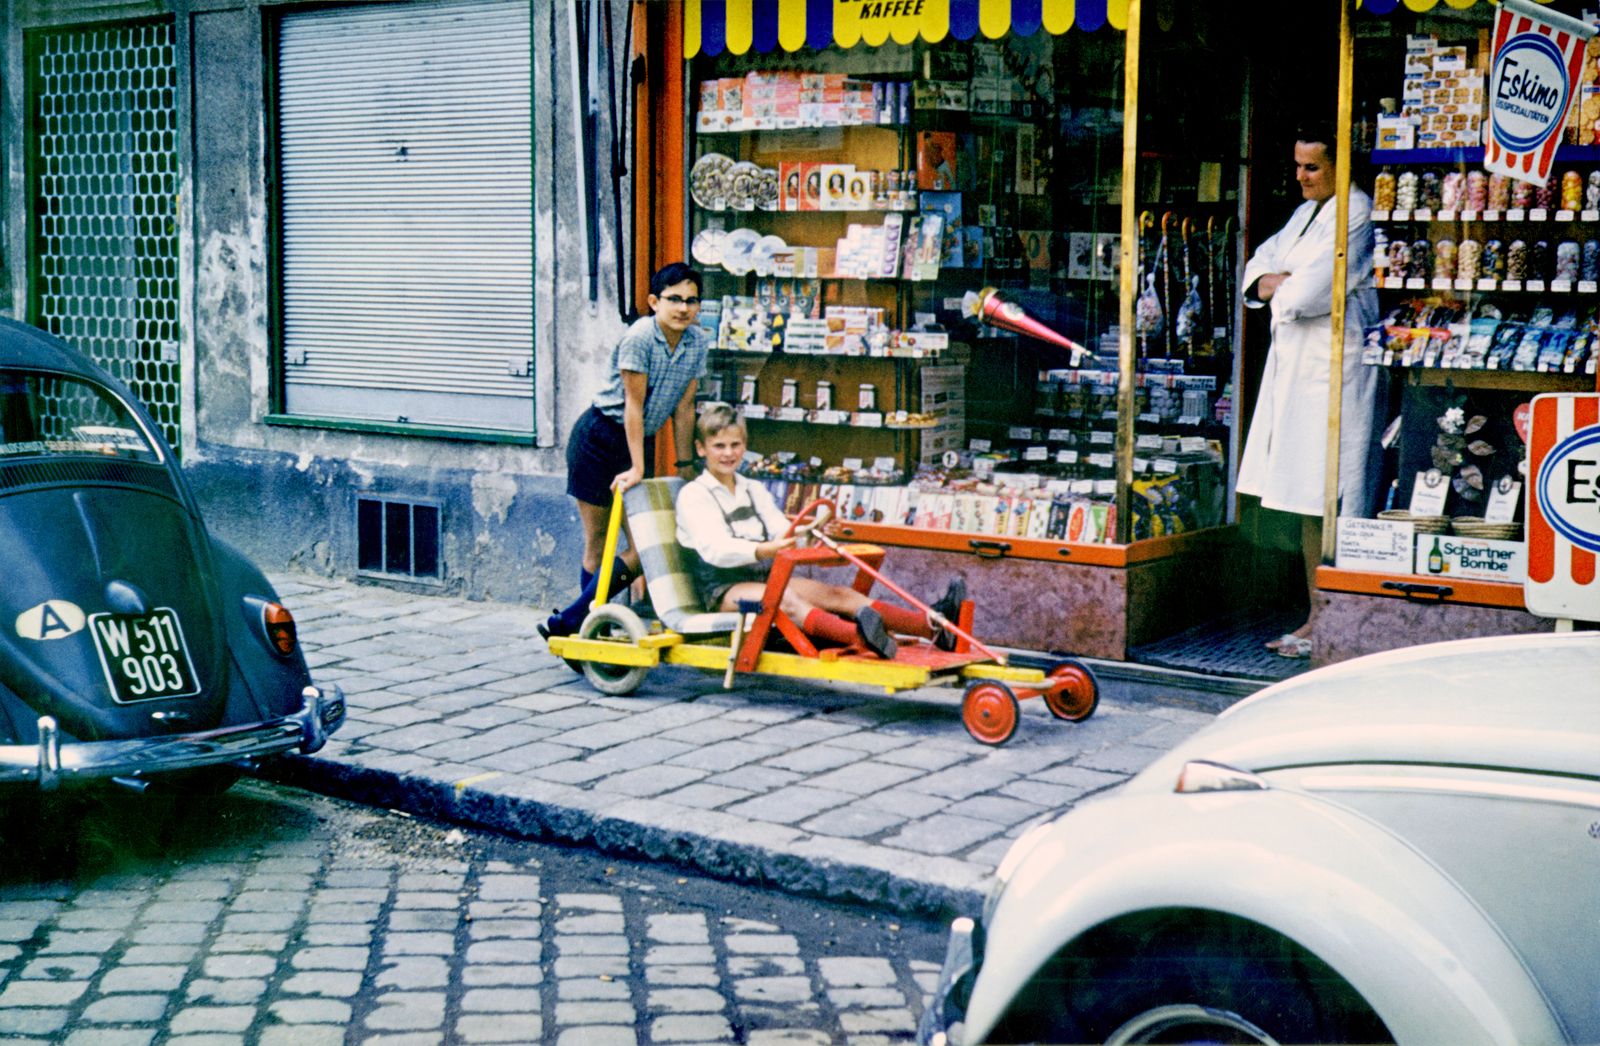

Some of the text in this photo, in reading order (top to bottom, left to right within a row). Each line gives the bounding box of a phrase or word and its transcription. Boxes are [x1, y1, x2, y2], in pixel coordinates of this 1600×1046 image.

[859, 0, 926, 19] KAFFEE
[1497, 57, 1558, 110] Eskimo
[1443, 542, 1516, 560] Schartner
[1460, 556, 1508, 572] Bombe
[40, 603, 72, 639] A
[97, 615, 180, 658] W 511
[121, 653, 184, 695] 903
